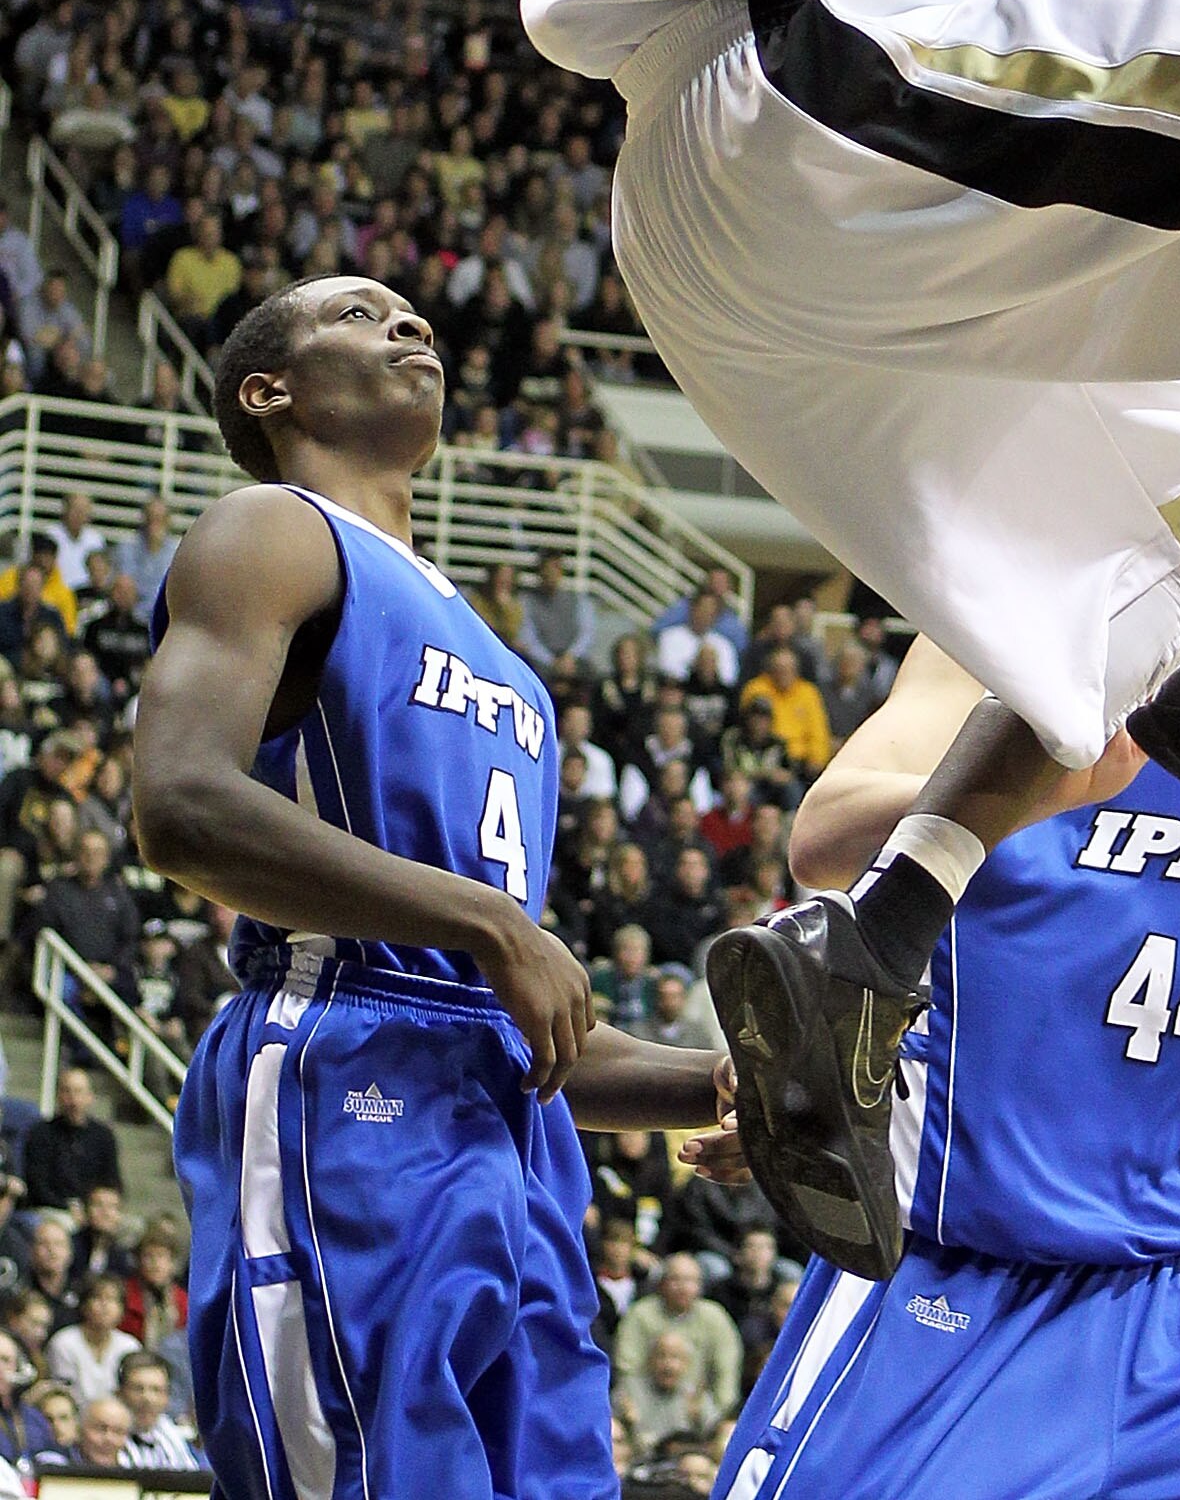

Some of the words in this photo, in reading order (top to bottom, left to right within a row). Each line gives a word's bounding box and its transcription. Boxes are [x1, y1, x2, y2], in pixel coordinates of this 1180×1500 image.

[407, 643, 546, 763] IPFW
[477, 766, 528, 904] 4
[343, 1097, 404, 1116] SUMMIT
[356, 1113, 394, 1123] LEAGUE
[905, 1299, 971, 1330] SUMMIT
